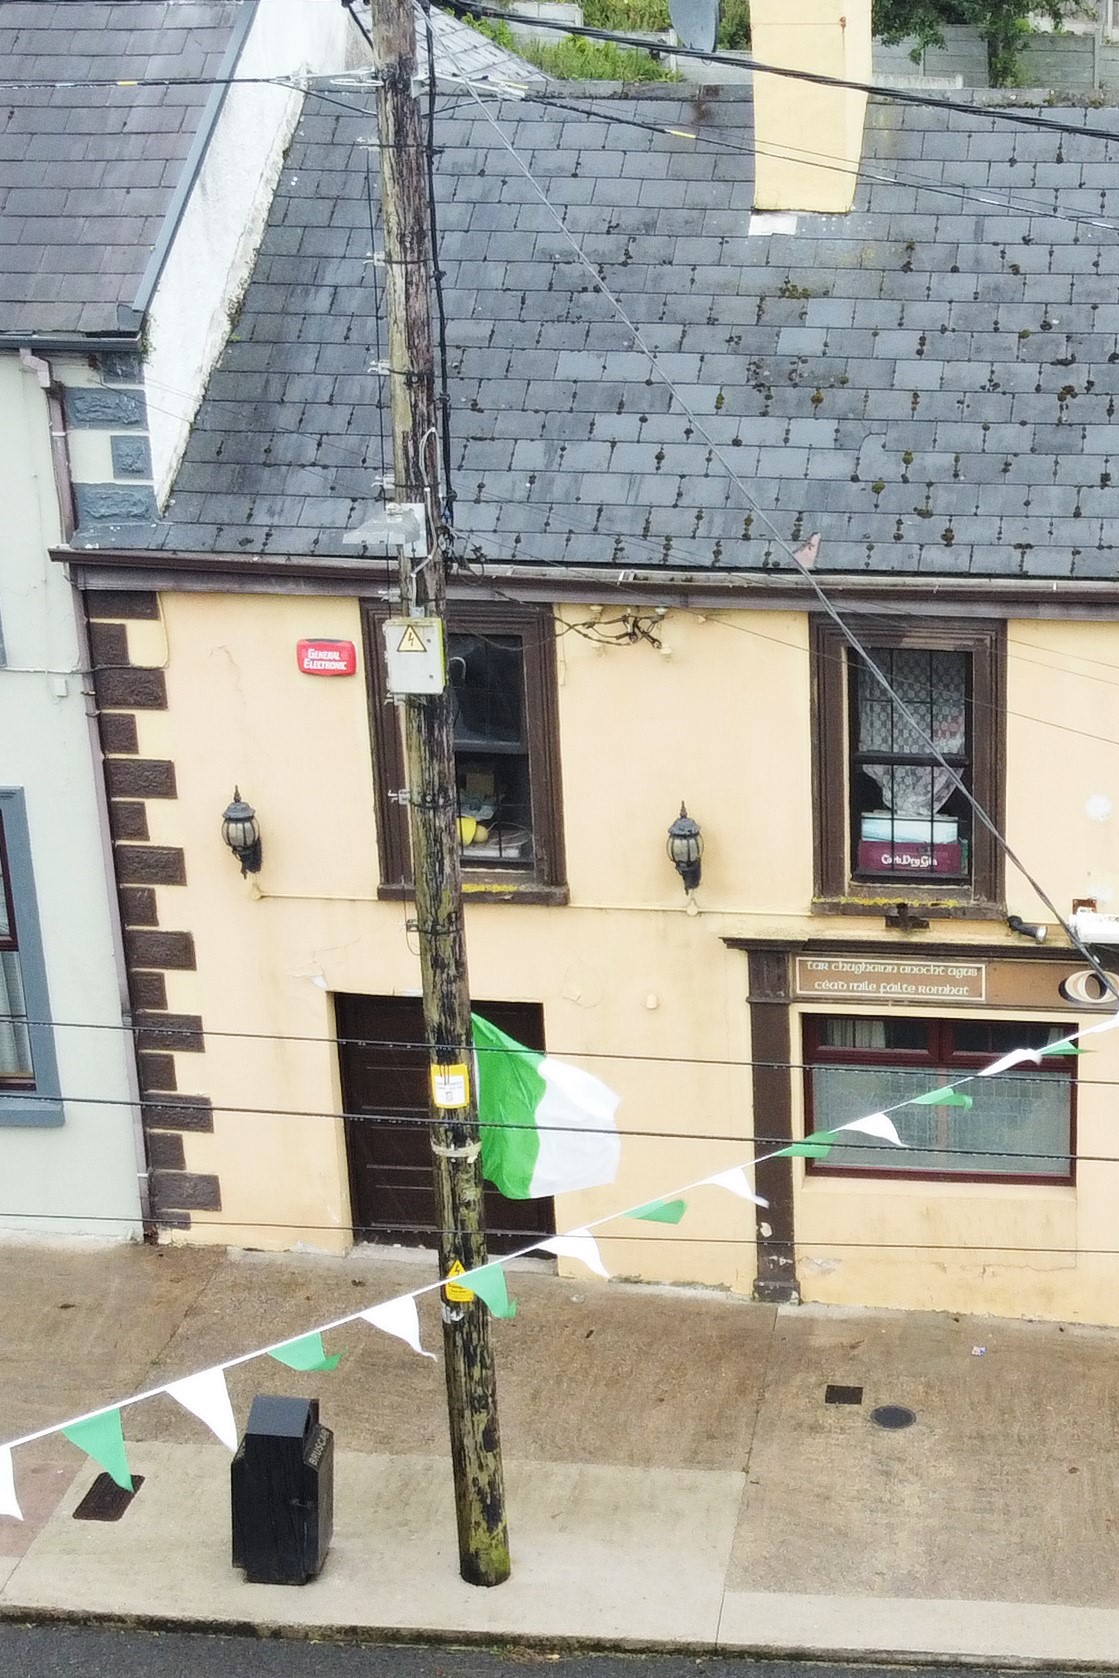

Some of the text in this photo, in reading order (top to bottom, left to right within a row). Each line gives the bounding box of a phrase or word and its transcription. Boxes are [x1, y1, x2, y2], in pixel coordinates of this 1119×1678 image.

[308, 648, 340, 660] GENERAL
[304, 659, 347, 670] ELECTRONIC
[899, 963, 946, 976] anocht
